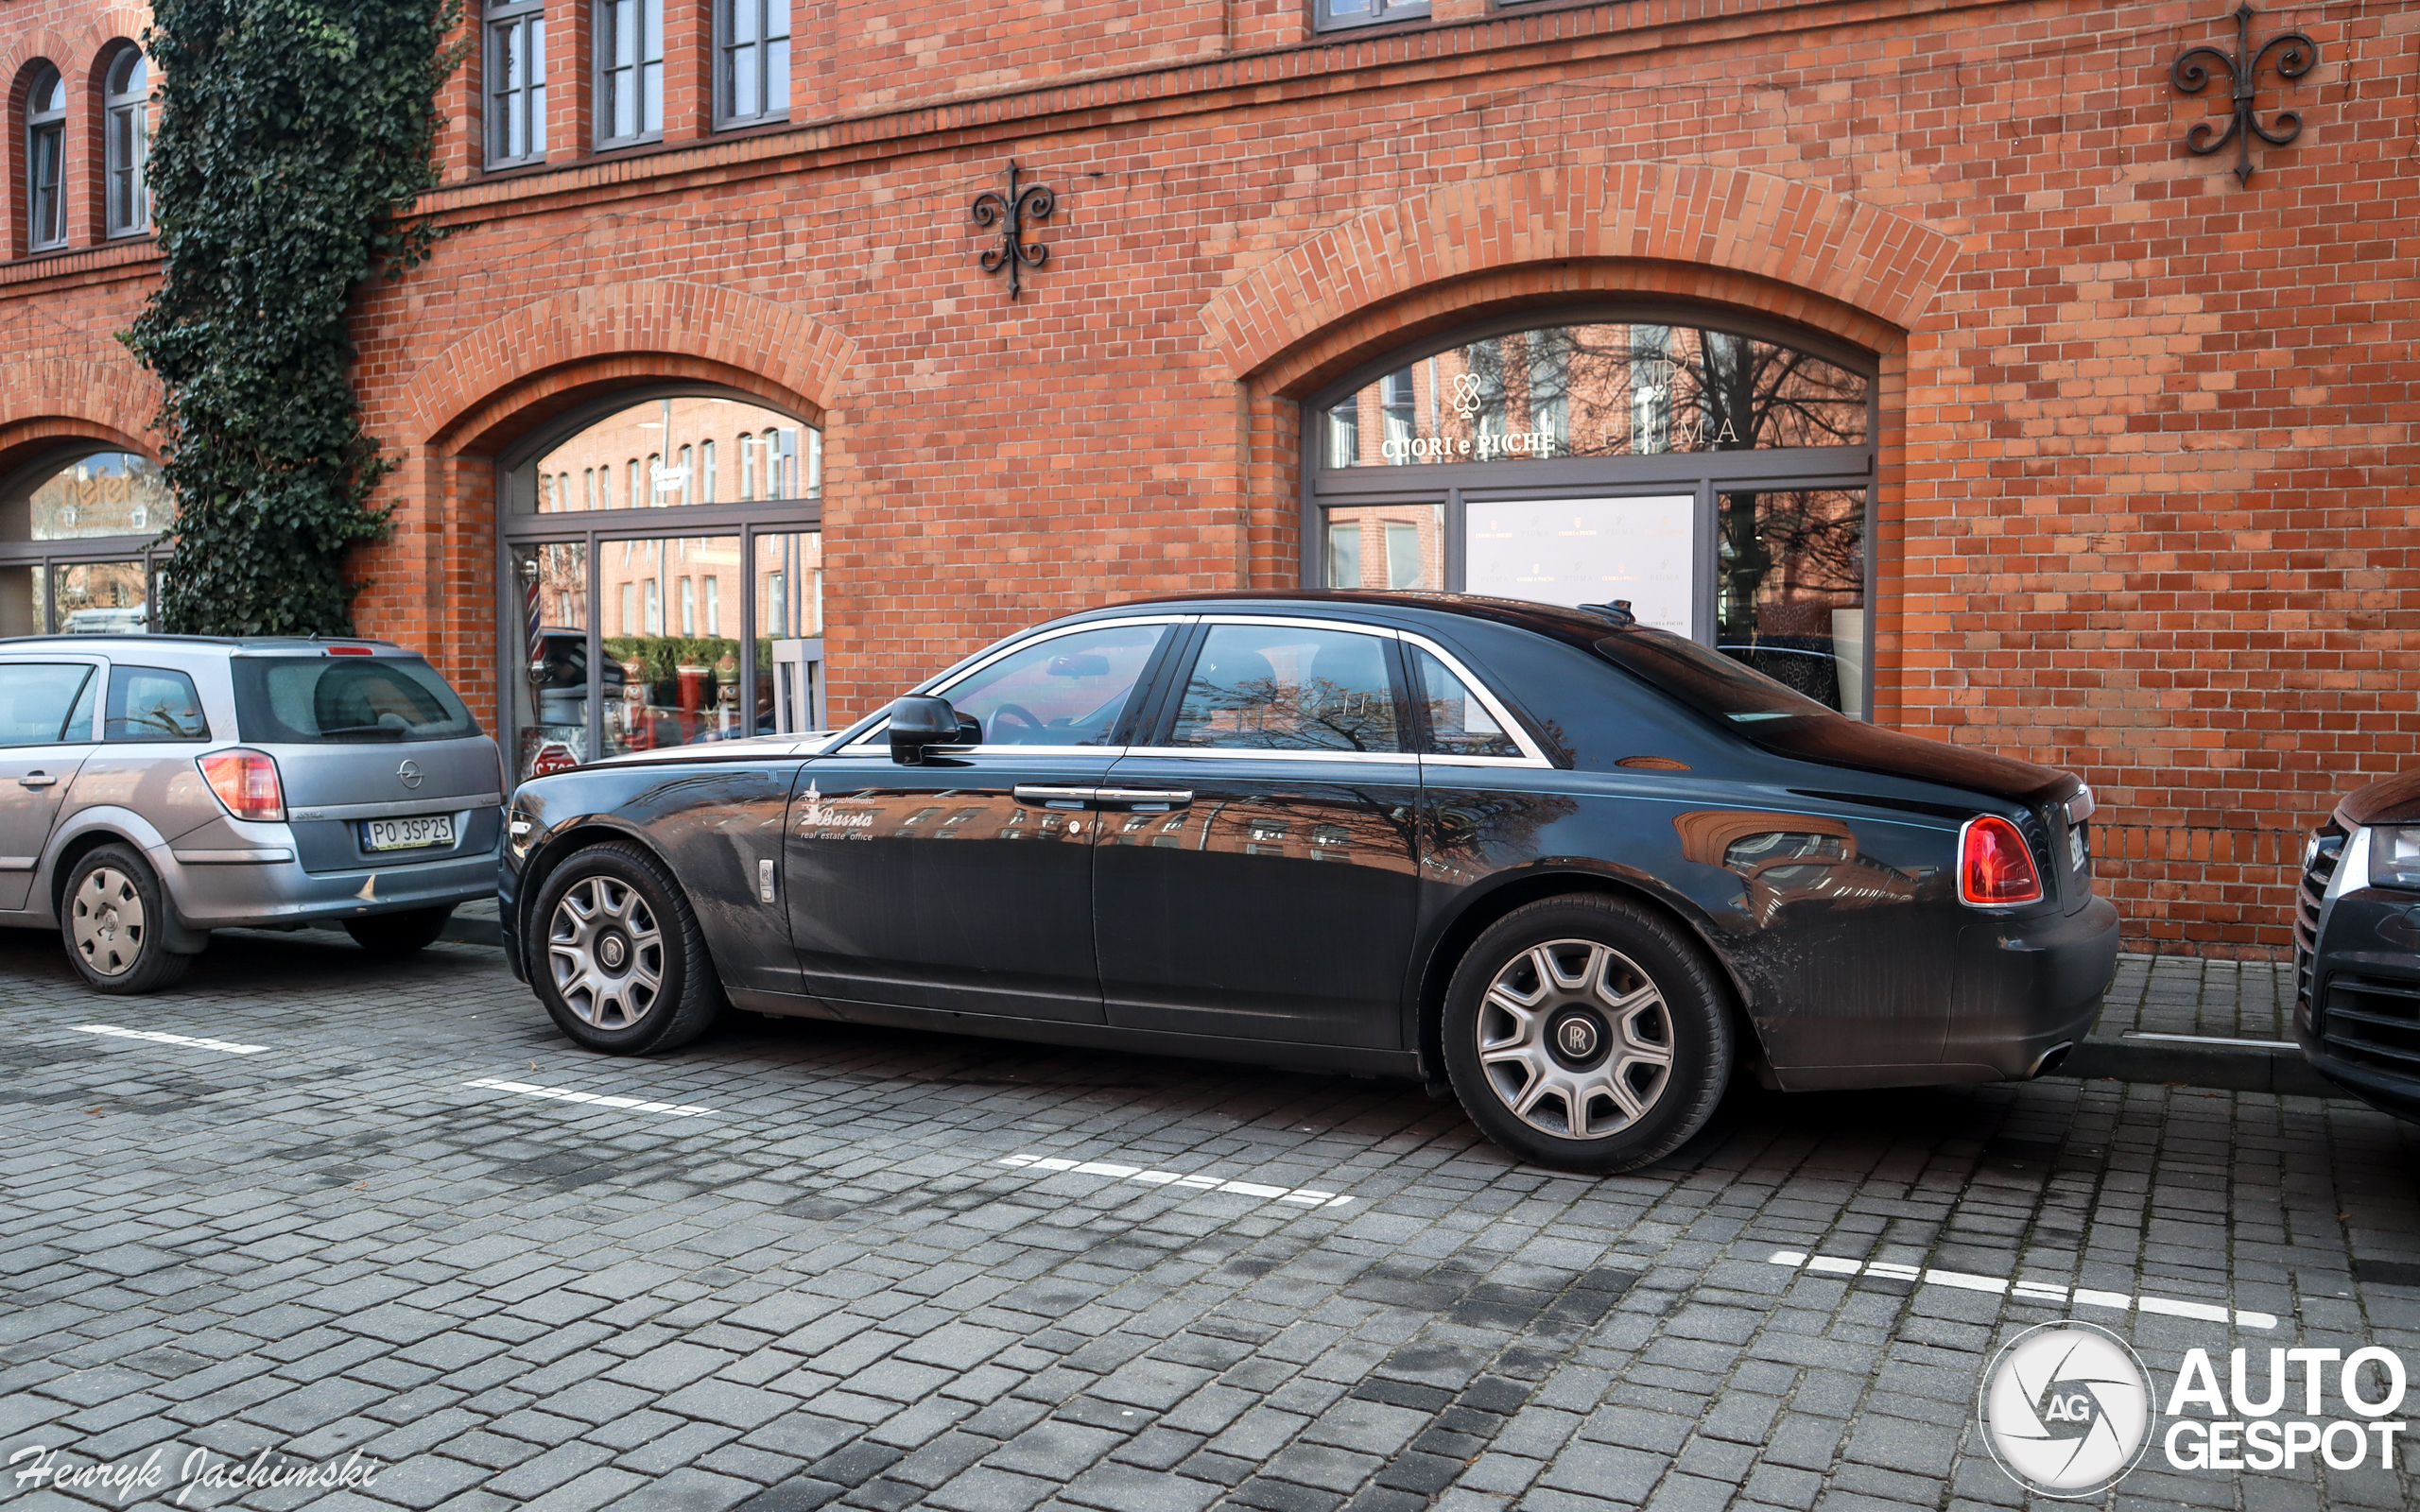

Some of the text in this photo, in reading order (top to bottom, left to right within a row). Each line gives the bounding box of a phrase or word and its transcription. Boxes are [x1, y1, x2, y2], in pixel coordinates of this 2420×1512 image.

[1600, 417, 1739, 447] PIUMA
[1381, 437, 1452, 458] CUORI
[1458, 439, 1471, 454] e
[63, 466, 132, 506] nefer
[822, 796, 875, 805] nieruchomości
[815, 806, 873, 827] Baszta
[372, 817, 449, 843] PO 3SP25
[821, 832, 846, 840] estate
[850, 832, 873, 841] office
[1569, 1025, 1586, 1050] RR
